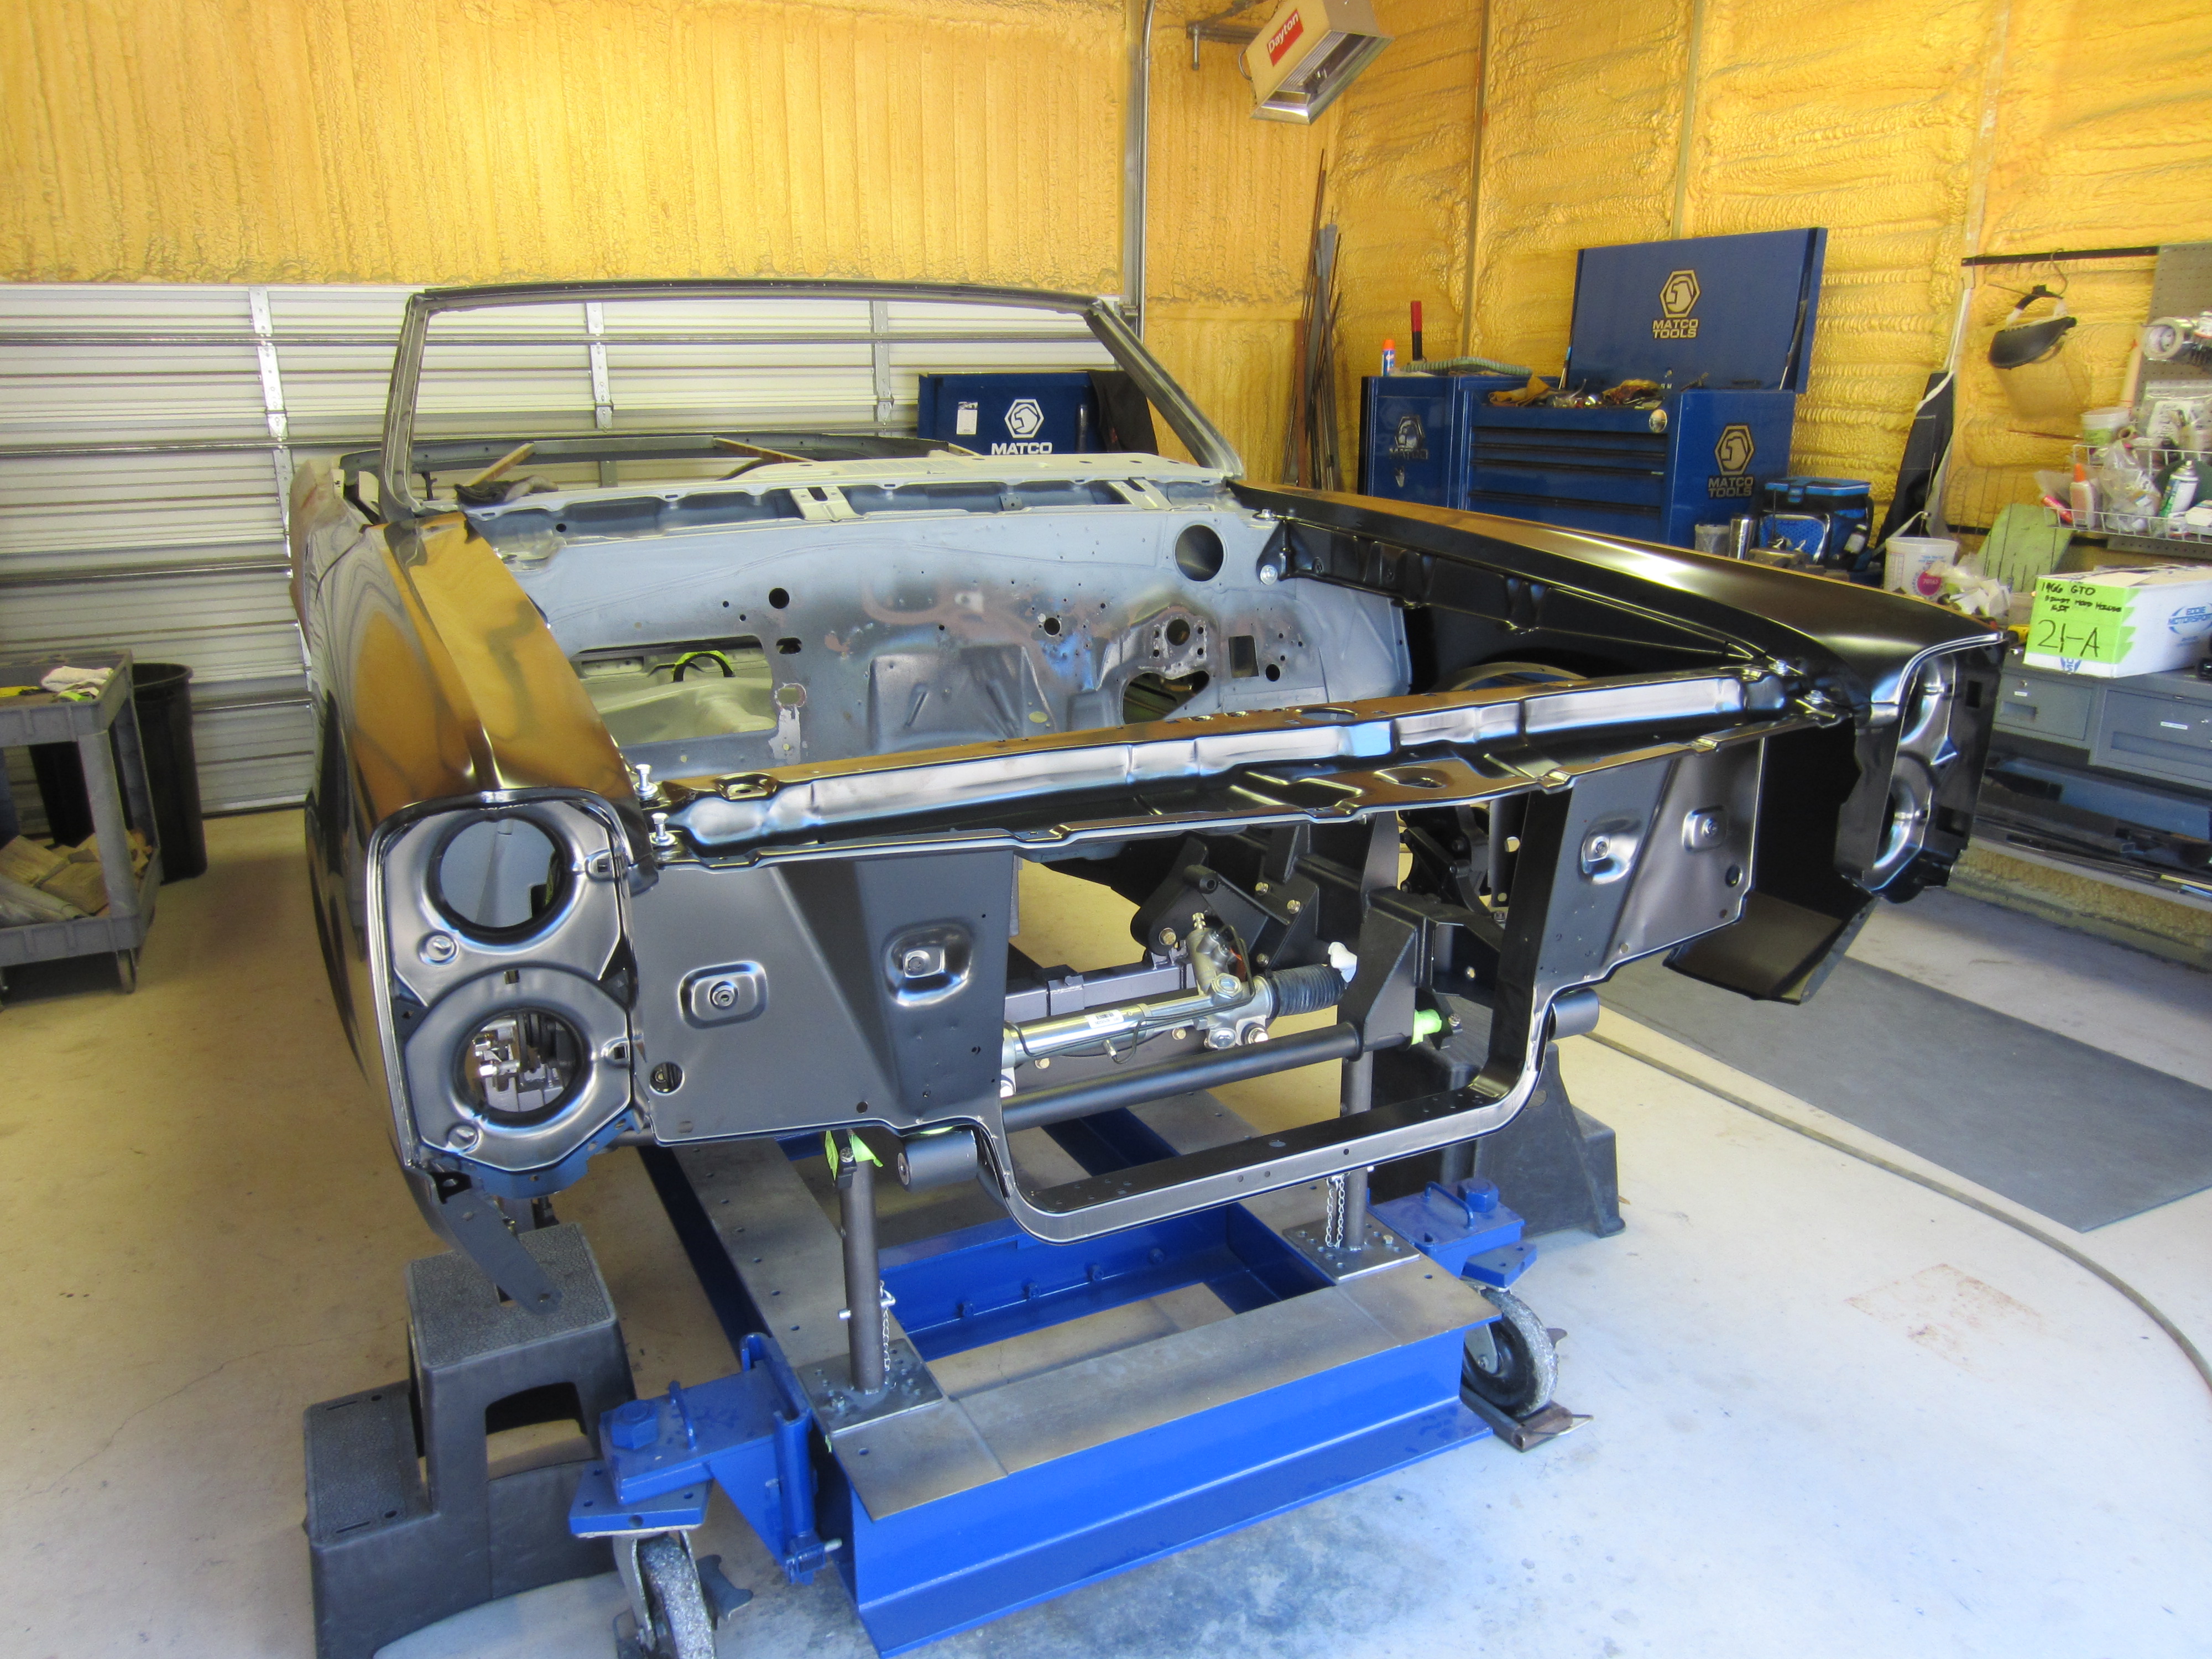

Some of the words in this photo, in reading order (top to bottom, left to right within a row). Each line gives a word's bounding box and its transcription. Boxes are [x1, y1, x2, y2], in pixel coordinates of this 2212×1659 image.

[1268, 13, 1298, 53] Dayton
[1652, 319, 1699, 329] MATCO
[1652, 328, 1697, 339] TOOLS
[991, 442, 1053, 455] MATCO
[1708, 476, 1754, 488] MATCO
[1708, 487, 1752, 498] TOOLS
[2041, 582, 2063, 593] 1966
[2070, 585, 2096, 596] GTO
[2037, 619, 2100, 658] 21-A
